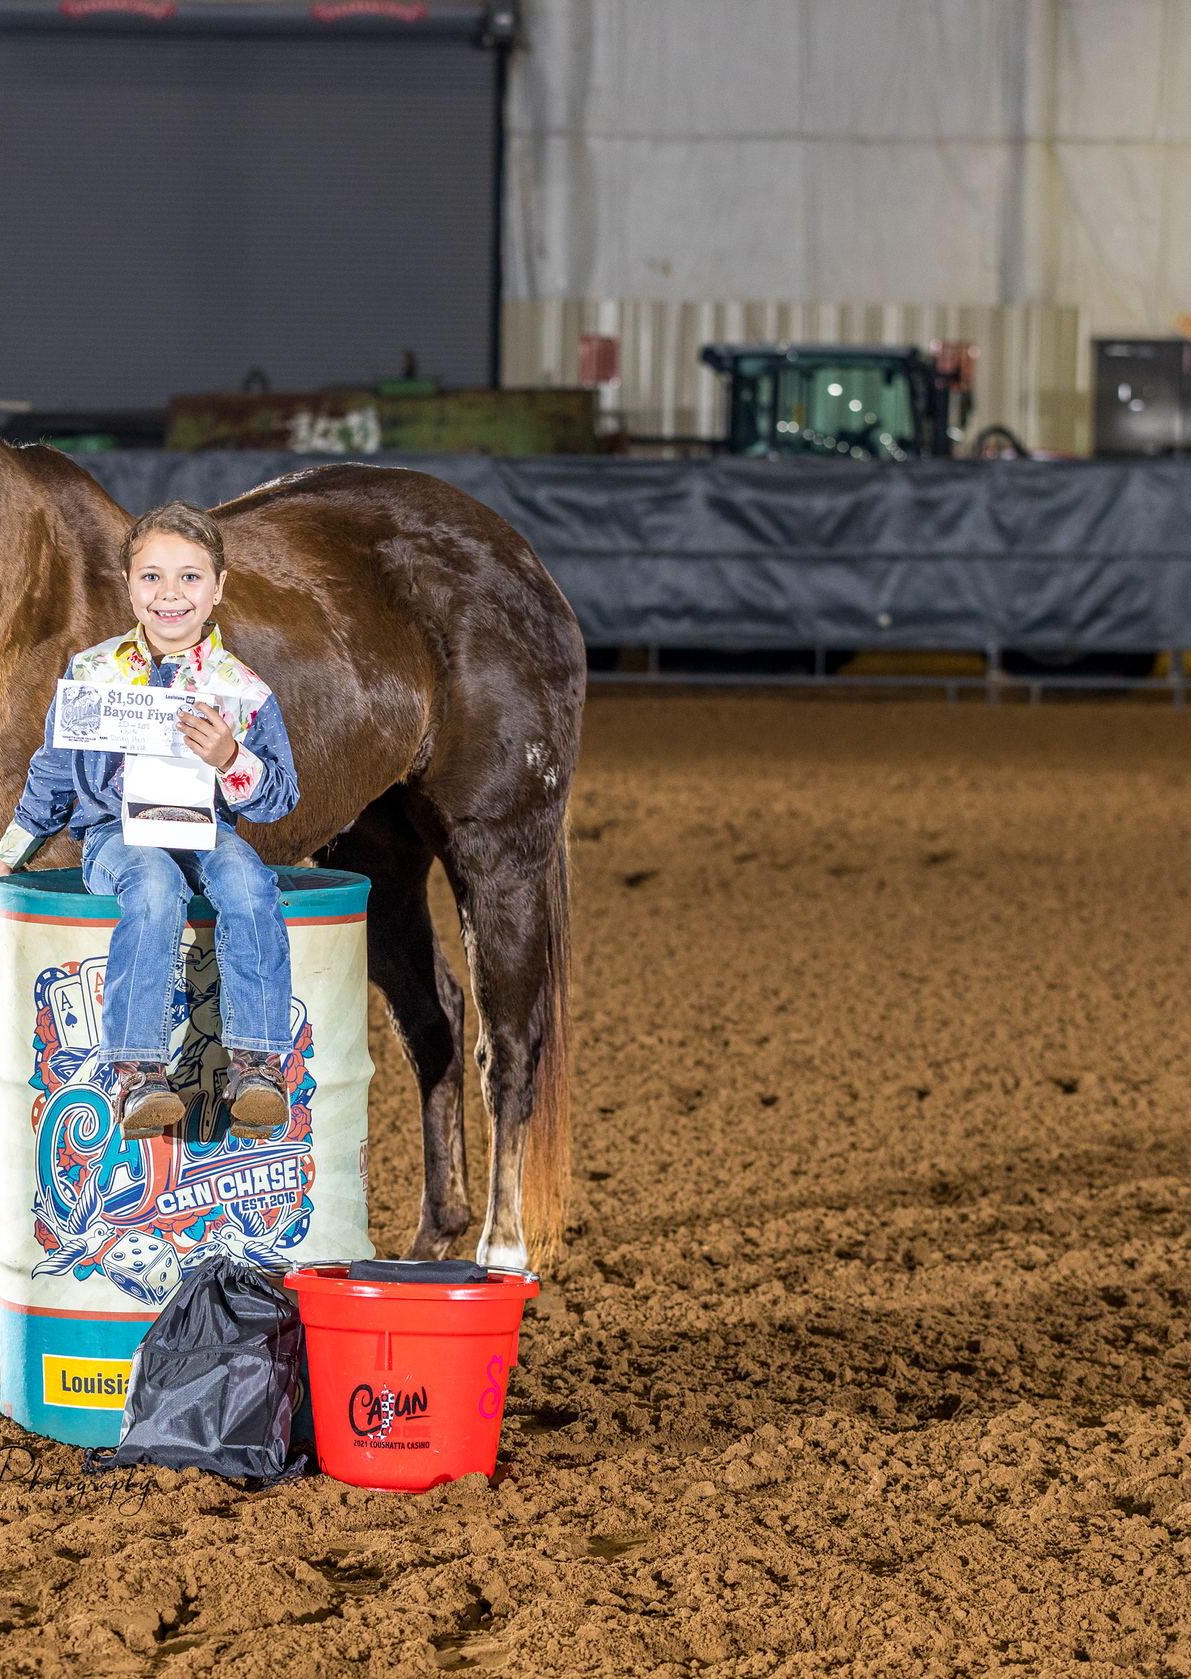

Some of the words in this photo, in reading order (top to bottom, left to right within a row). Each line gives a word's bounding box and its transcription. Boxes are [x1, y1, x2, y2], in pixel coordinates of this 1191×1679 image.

[107, 689, 153, 706] $1,500
[103, 705, 143, 721] Bayou
[147, 708, 174, 724] Fiya
[61, 990, 73, 1012] A
[156, 1181, 215, 1215] CAN
[217, 1158, 298, 1201] CHASE
[269, 1191, 297, 1207] 2016
[353, 1440, 368, 1448] 2021
[369, 1441, 406, 1450] COUSHATTA
[406, 1441, 430, 1449] CASINO
